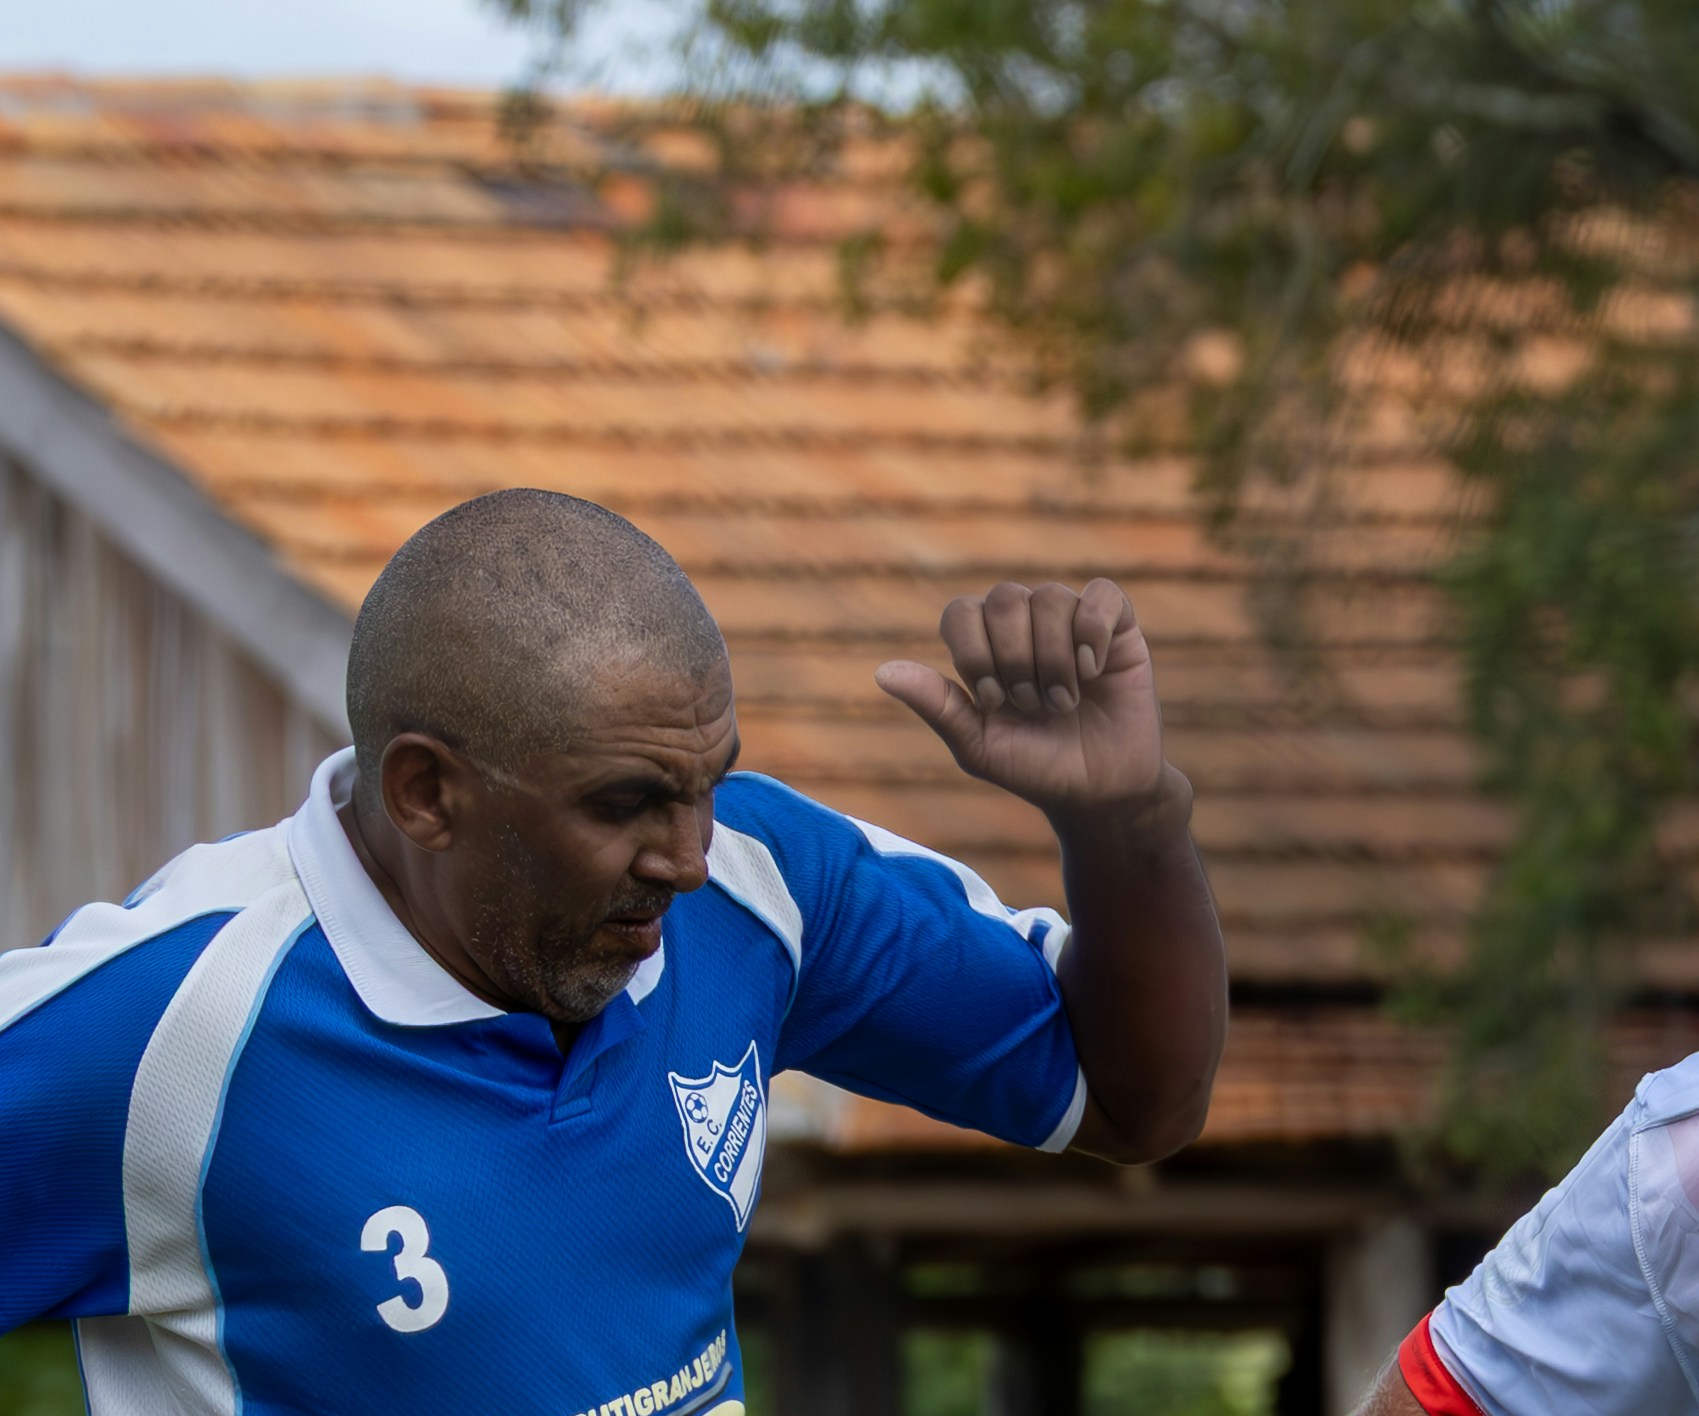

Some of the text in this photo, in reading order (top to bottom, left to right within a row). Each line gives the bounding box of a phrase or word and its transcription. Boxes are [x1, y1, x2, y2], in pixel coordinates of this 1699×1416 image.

[697, 1118, 723, 1155] E. C.
[714, 1079, 758, 1183] CORRIENTES
[360, 1205, 449, 1333] 3
